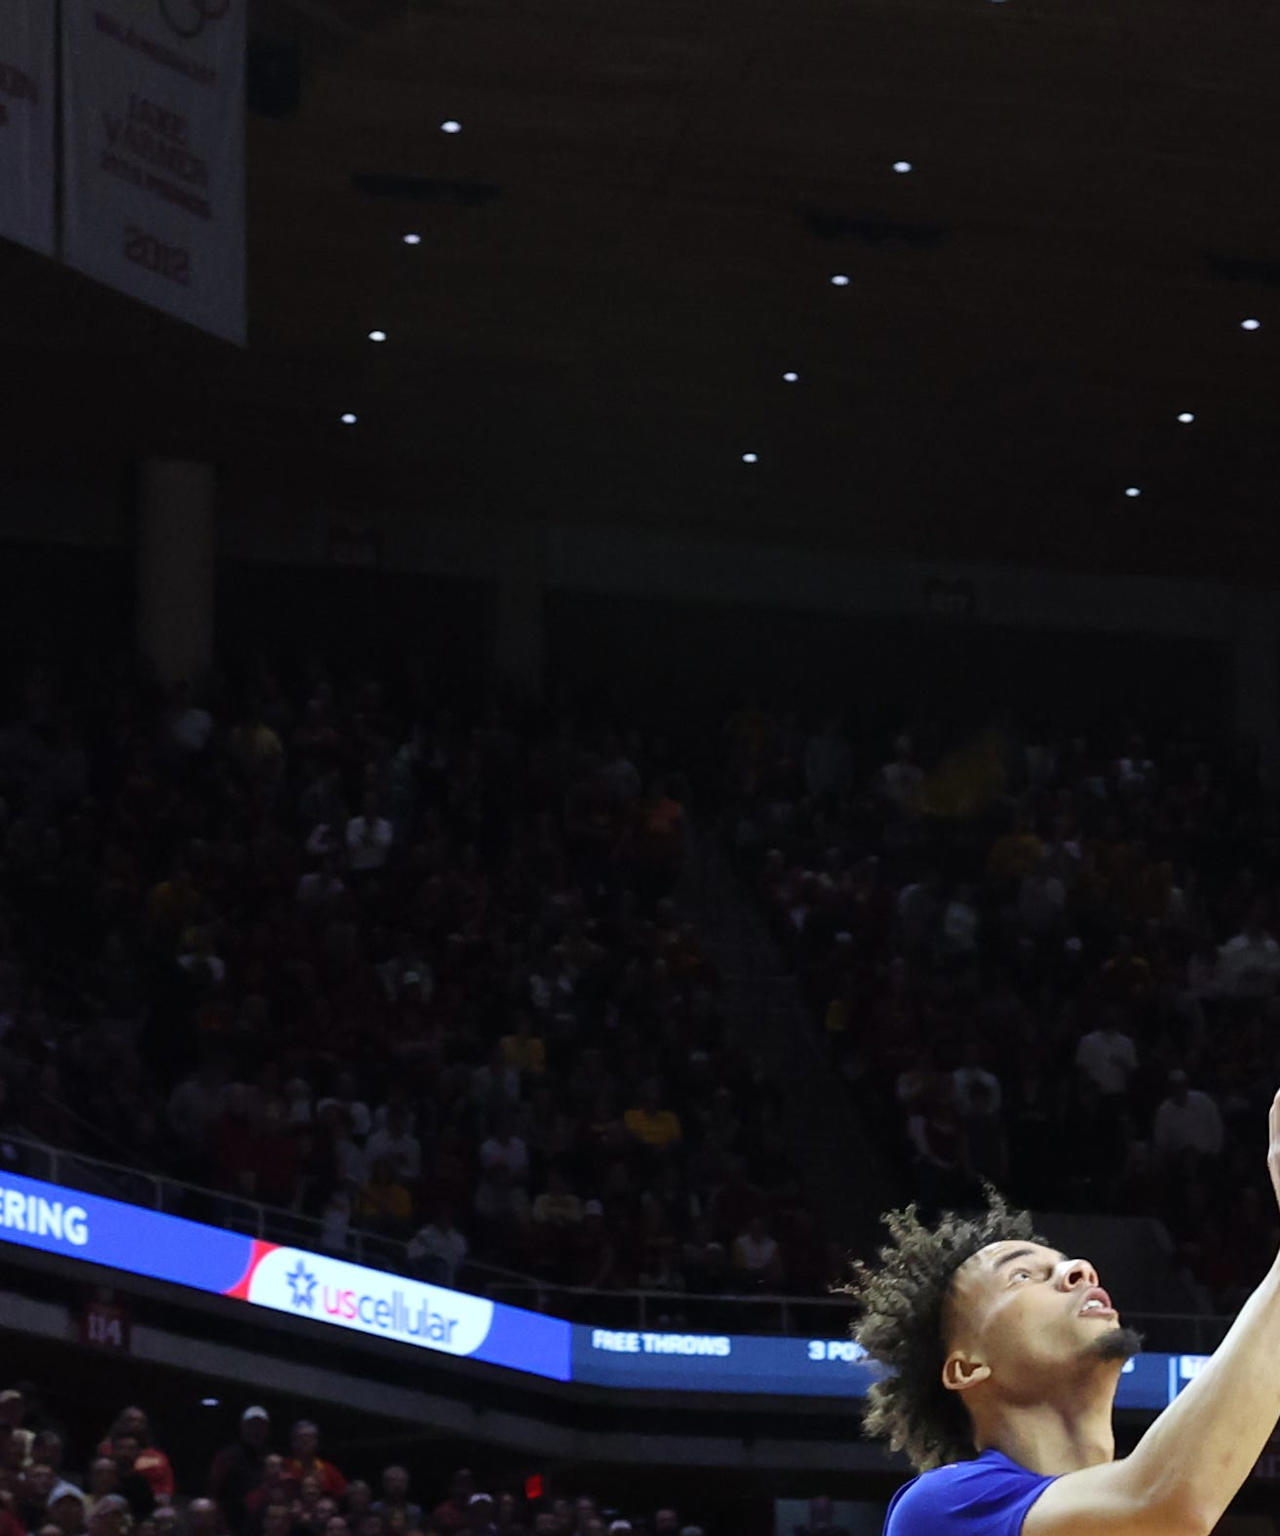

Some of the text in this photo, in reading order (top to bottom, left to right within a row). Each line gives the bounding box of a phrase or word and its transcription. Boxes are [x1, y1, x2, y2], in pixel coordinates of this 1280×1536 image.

[0, 1187, 89, 1246] RING
[323, 1286, 458, 1344] uscellular
[592, 1329, 731, 1357] FREE THROWS
